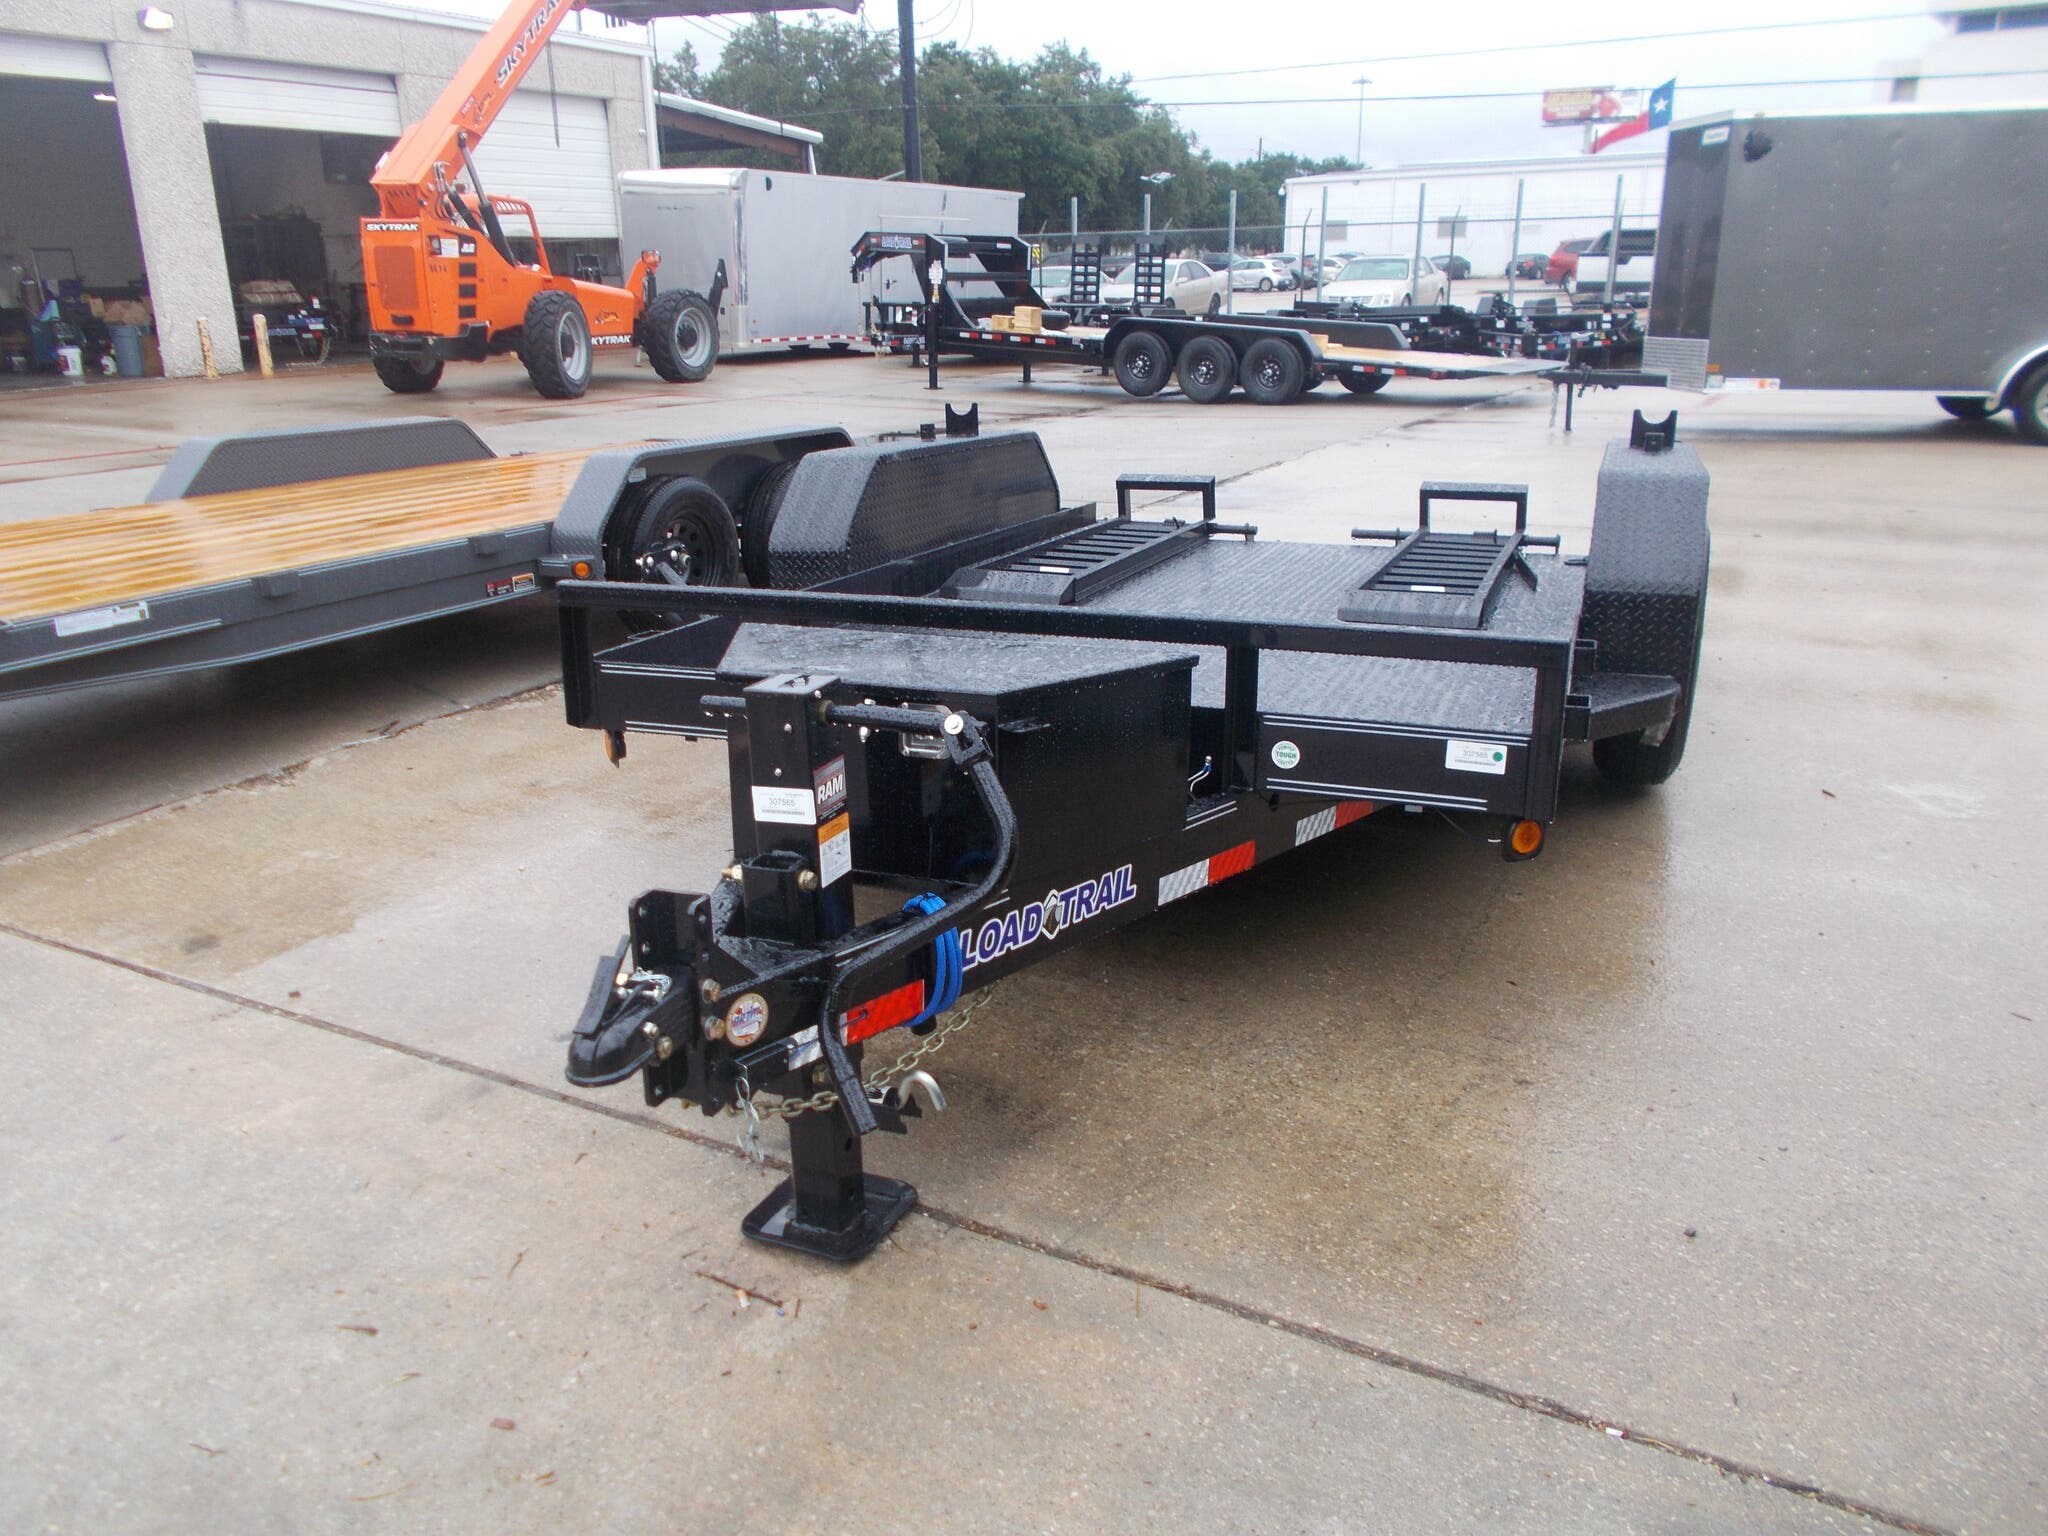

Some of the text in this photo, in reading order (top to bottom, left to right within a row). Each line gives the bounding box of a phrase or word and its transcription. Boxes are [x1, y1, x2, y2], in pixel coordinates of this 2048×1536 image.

[497, 0, 560, 88] SKYTRA
[366, 223, 418, 231] SKYTRAK
[591, 335, 632, 345] KYTRAK
[818, 774, 843, 804] RAM
[960, 864, 1137, 972] LOAD TRAIL
